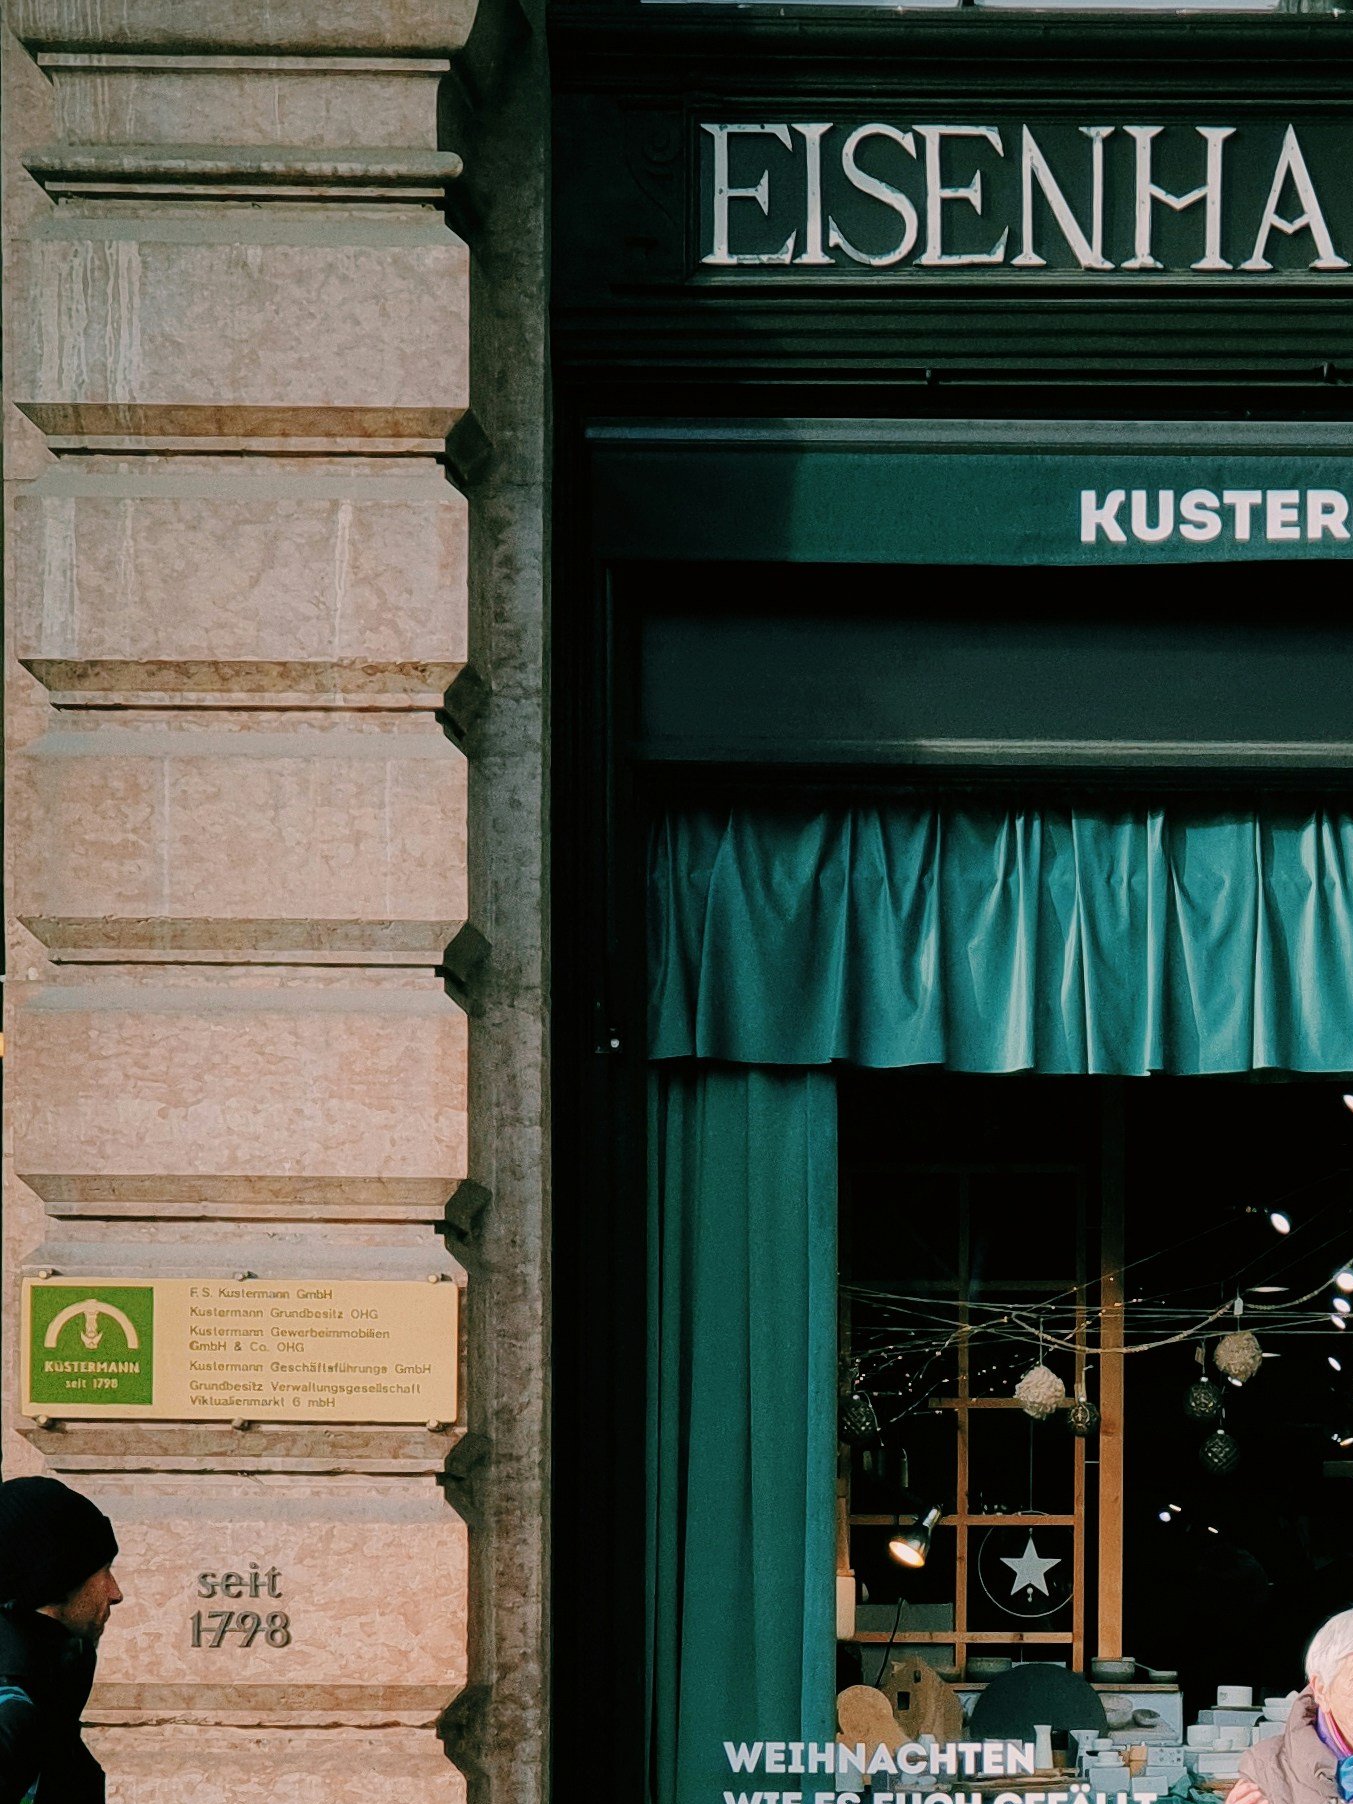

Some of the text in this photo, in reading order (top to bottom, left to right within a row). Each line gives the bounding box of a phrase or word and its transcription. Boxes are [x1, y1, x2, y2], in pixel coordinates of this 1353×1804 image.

[218, 1288, 290, 1299] Kustermann
[296, 1289, 333, 1300] GmbH
[189, 1306, 379, 1320] Kustermann Grundbesitz OHG
[189, 1325, 390, 1339] Kustermann Gewerbeimmobilien
[189, 1340, 227, 1352] GmbH
[234, 1341, 242, 1351] &
[276, 1342, 305, 1352] OHG
[44, 1361, 140, 1373] KUSTERMANN
[189, 1361, 432, 1376] Kustermann Geschäftsführungs GmbH
[65, 1378, 118, 1389] seit 1798
[189, 1380, 421, 1396] Grundbesitz Verwaltungsgesellschaft
[190, 1396, 336, 1408] Viktualienmarkt 6 mbH
[197, 1562, 283, 1599] seit
[189, 1610, 292, 1649] 1798
[723, 1741, 1037, 1775] WEIHNACHTEN
